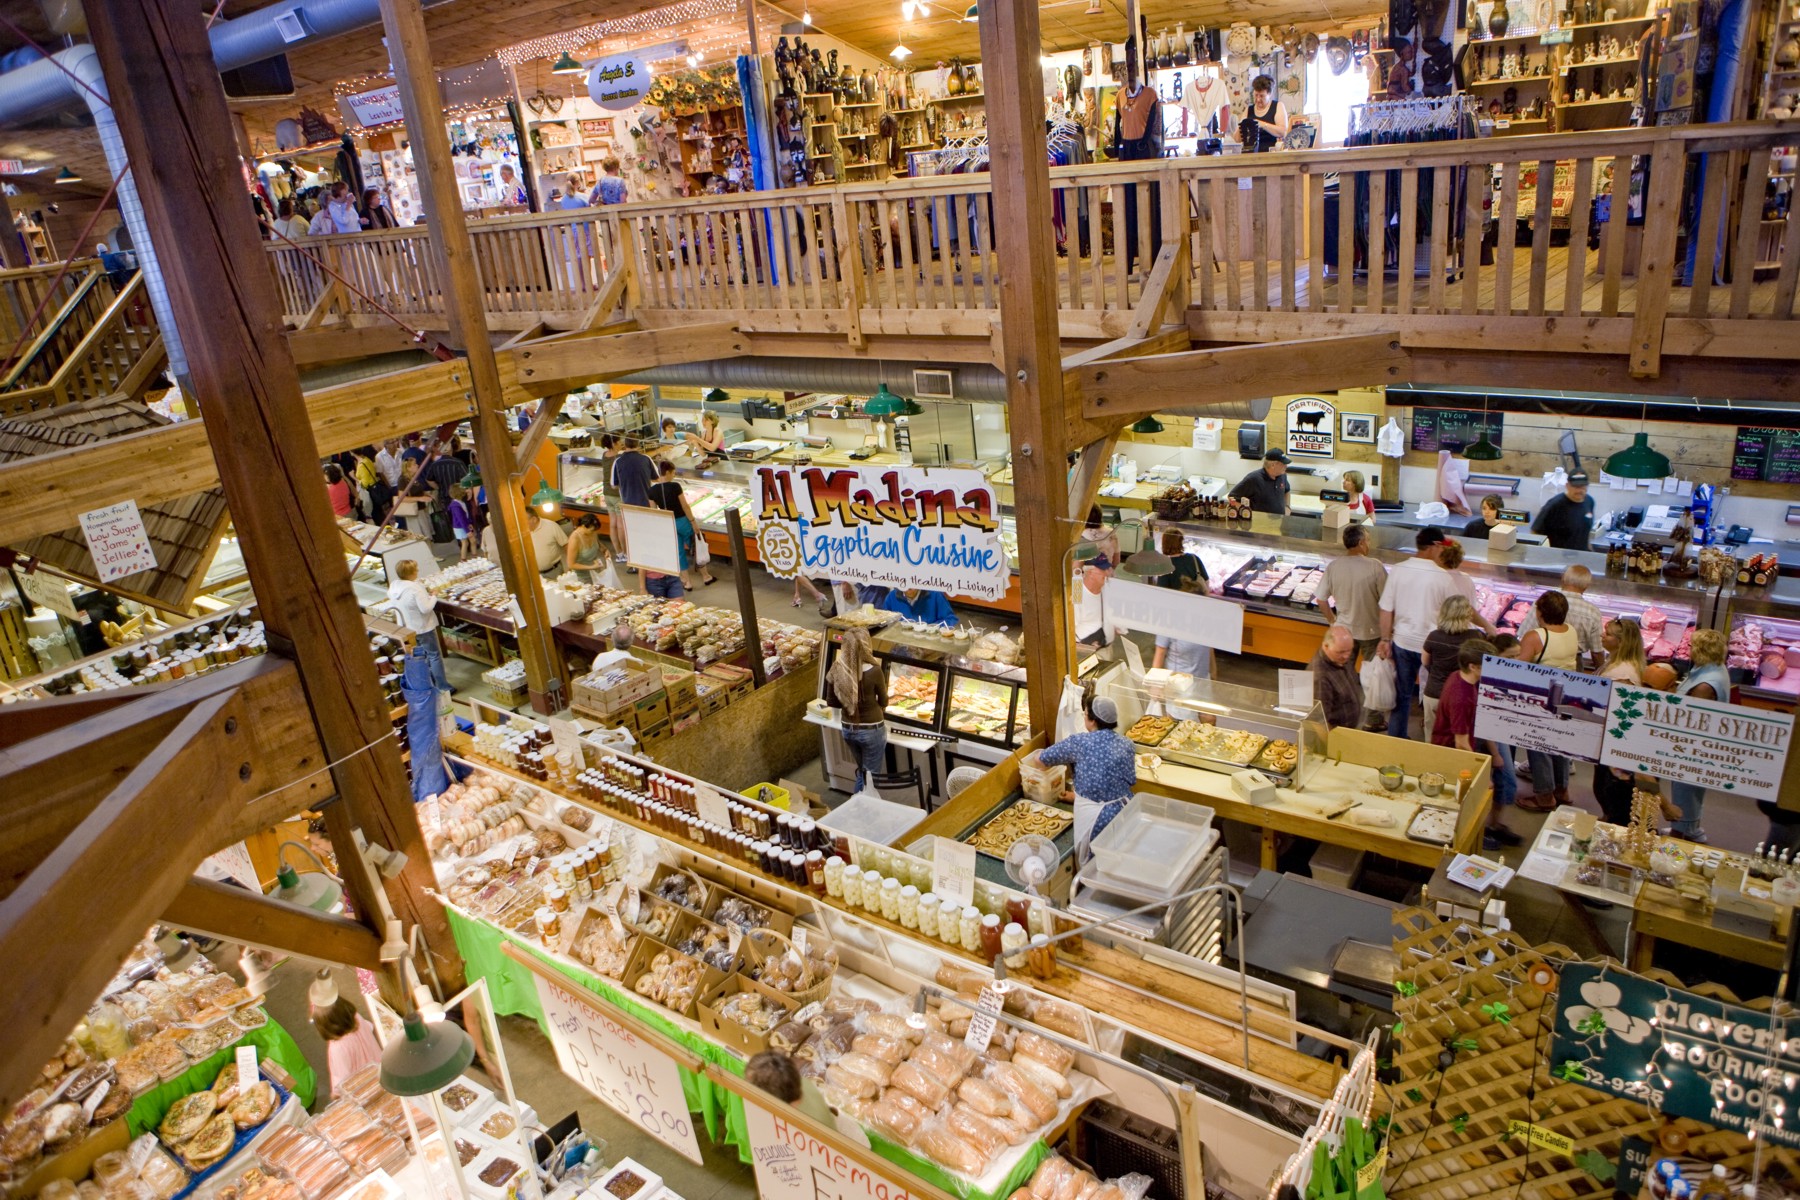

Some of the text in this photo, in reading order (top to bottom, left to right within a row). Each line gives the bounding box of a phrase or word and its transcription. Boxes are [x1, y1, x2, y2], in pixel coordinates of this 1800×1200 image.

[1289, 401, 1332, 415] CERTIFIED
[1290, 434, 1332, 444] ANGUS
[1295, 442, 1325, 450] BEEF
[757, 468, 999, 533] Al Madina
[87, 504, 130, 521] fresh fruit
[89, 523, 140, 542] Low Sugar
[798, 514, 998, 572] Egyptian Cuisine
[101, 540, 129, 552] Jams
[766, 538, 793, 559] 25
[102, 550, 138, 565] Jellies
[830, 566, 999, 598] Healthy Eating Healthy Living!
[1496, 659, 1597, 685] Pure Maple Syrup
[1643, 701, 1787, 746] MAPLE SYRUP
[1649, 729, 1774, 760] Edgar Gingrich
[1655, 750, 1715, 766] ELMIRA
[1672, 745, 1745, 766] & Family
[1610, 749, 1773, 789] PRODUCERS OF PURE MAPLE SYRUP
[1650, 765, 1721, 787] Since 1987
[550, 1012, 583, 1036] Fresh
[588, 1026, 659, 1097] Fruit
[1710, 1077, 1786, 1115] FOOD
[1710, 1107, 1741, 1125] New
[1513, 1121, 1569, 1150] Suga Free Candies
[754, 1144, 795, 1162] DELICIOUS
